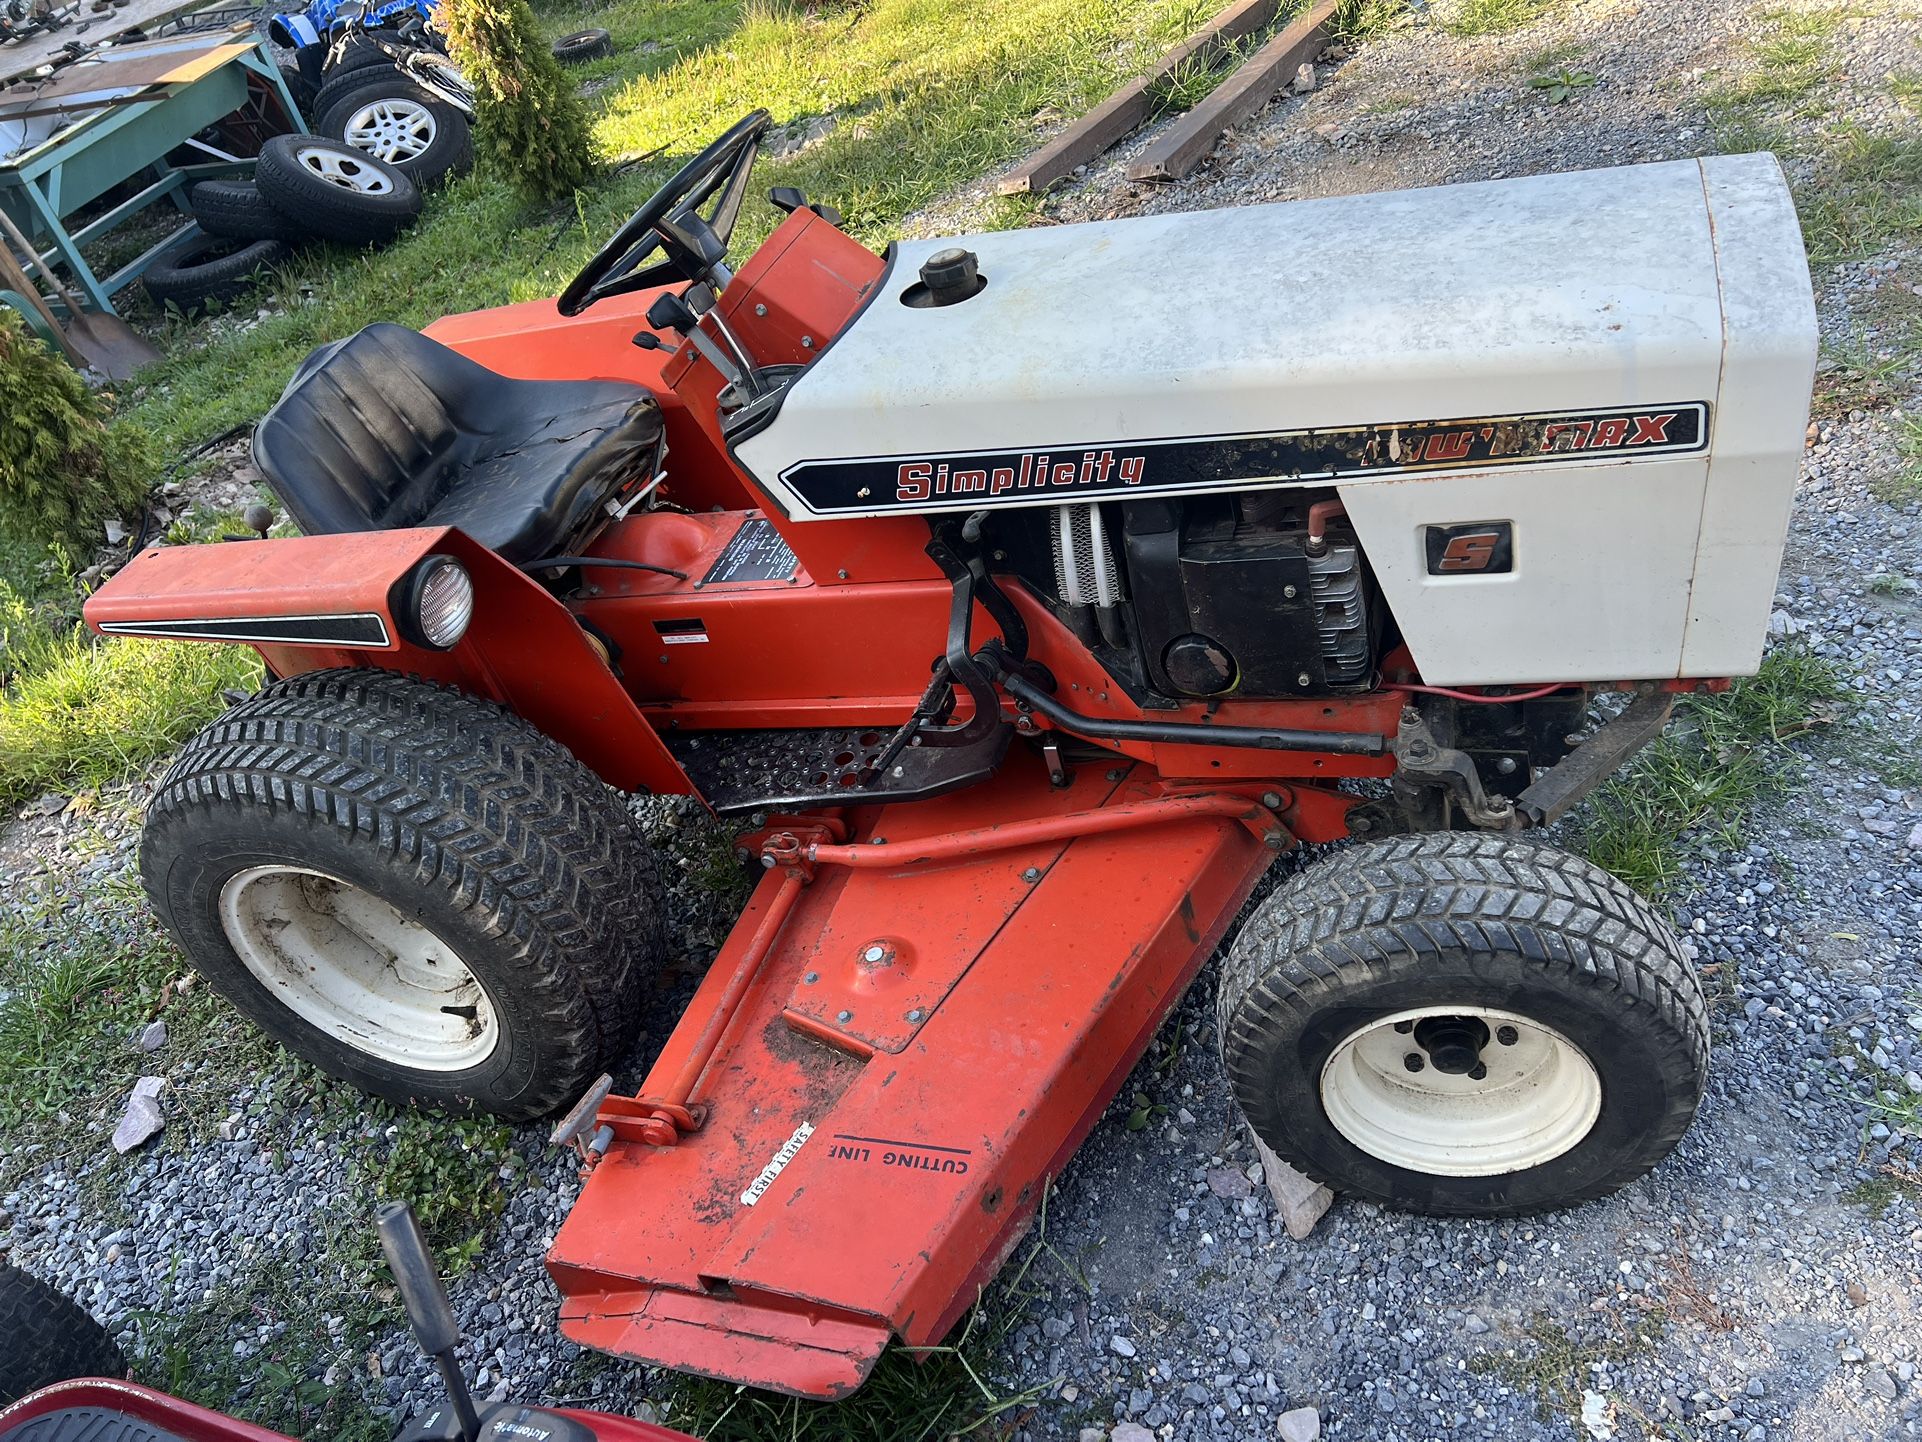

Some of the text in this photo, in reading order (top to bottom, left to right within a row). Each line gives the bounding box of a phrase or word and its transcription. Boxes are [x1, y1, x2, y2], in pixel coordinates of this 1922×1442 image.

[896, 451, 1146, 501] Simplicity
[1439, 532, 1500, 571] S
[751, 1132, 808, 1199] SAFETY FIRST
[883, 1152, 968, 1175] CUTTING
